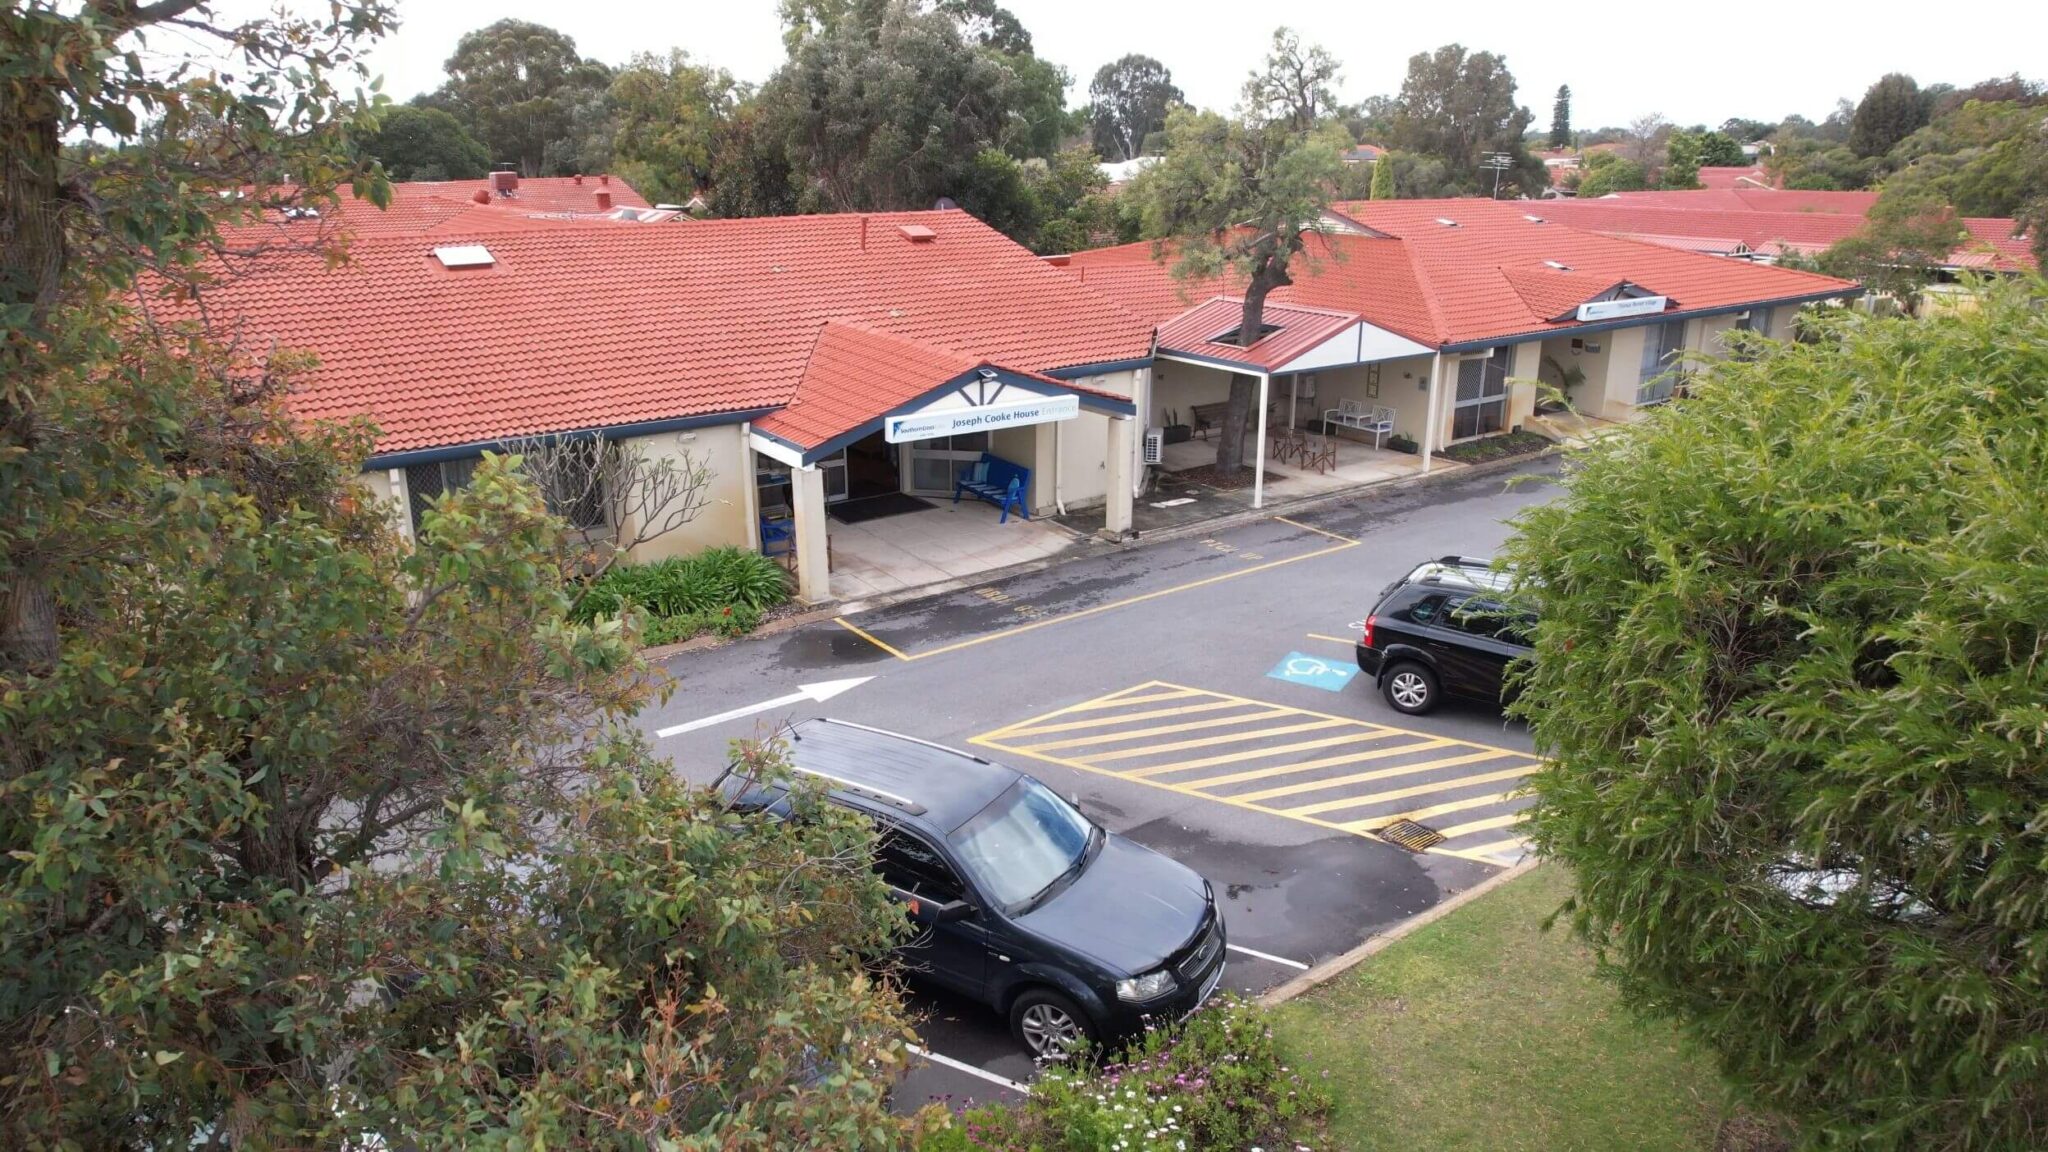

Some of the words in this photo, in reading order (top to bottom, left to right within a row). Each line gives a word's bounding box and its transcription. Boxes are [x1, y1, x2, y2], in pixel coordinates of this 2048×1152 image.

[952, 415, 983, 429] Joseph
[984, 412, 1011, 423] Cooke
[1013, 409, 1040, 419] House
